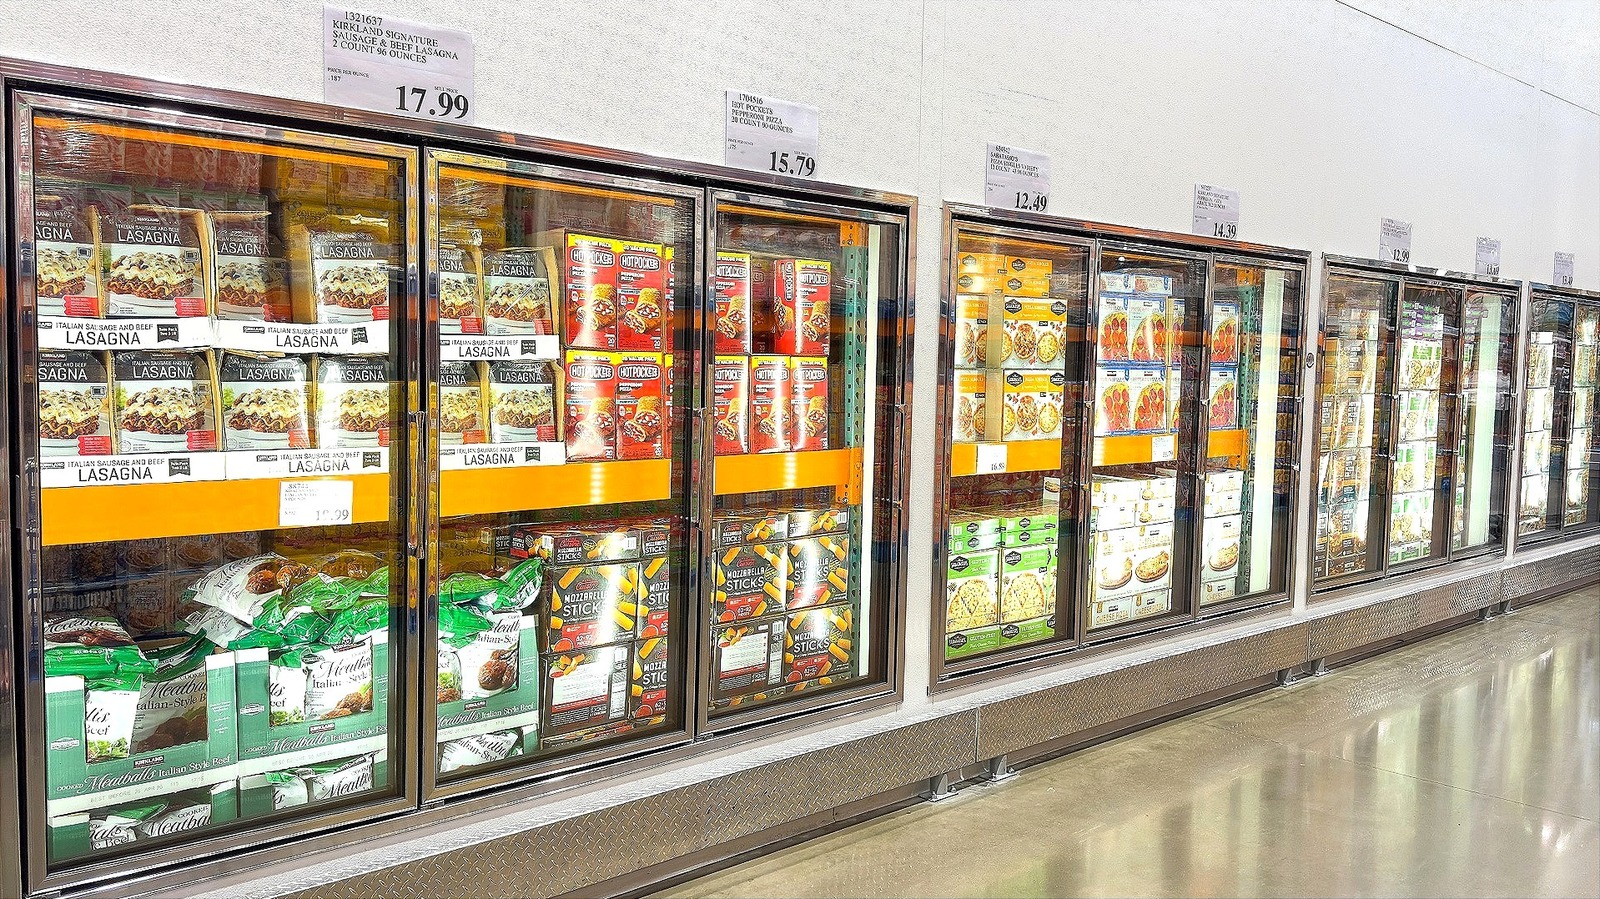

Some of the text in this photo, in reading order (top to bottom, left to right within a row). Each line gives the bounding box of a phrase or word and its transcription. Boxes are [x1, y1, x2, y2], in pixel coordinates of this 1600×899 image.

[345, 11, 383, 26] 1321637
[332, 20, 438, 48] KIRKLAND SIGNATURE
[332, 30, 459, 60] SAUSAGE & BEEF LASAGNA
[332, 40, 427, 64] 2 COUNT 96 OUNCES
[396, 85, 469, 120] 17.99
[732, 100, 774, 115] HOT POCKETS
[732, 108, 783, 125] PEPPERONI PIZZA
[732, 116, 738, 124] 20
[740, 117, 760, 128] COUNT
[770, 122, 793, 134] OUNCES
[769, 150, 816, 176] 15.79
[1015, 192, 1047, 212] 12.49
[36, 227, 74, 240] AGNA
[117, 231, 182, 245] LASAGNA
[1213, 222, 1237, 240] 14.39
[322, 246, 374, 258] LASAGNA
[440, 260, 464, 272] AGNA
[491, 266, 536, 276] LASAGNA
[56, 322, 84, 330] ITALIAN
[86, 323, 118, 331] SAUSAGE
[136, 323, 154, 331] BEEF
[268, 326, 290, 334] ITALIAN
[66, 330, 141, 345] LASAGNA
[276, 334, 338, 348] LASAGNA
[458, 346, 510, 358] LASAGNA
[38, 368, 88, 380] SAGNA
[133, 366, 194, 379] LASAGNA
[240, 368, 294, 380] LASAGNA
[340, 370, 384, 381] ASAGNA
[500, 372, 542, 383] LASAGNA
[440, 375, 466, 385] AGNA
[68, 460, 95, 468] ITALIAN
[97, 459, 130, 467] SAUSAGE
[288, 460, 350, 473] LASAGNA
[464, 454, 515, 466] LASAGNA
[78, 467, 153, 482] LASAGNA
[557, 552, 582, 560] STICKS
[644, 546, 667, 554] STICKS
[727, 566, 765, 579] MOZZARELLA
[726, 576, 764, 591] STICKS
[564, 590, 606, 603] MOZZARELL
[562, 602, 602, 616] STICK
[1135, 606, 1151, 616] CHEESE
[1096, 610, 1128, 625] CHEESE PIZZA
[793, 638, 830, 654] STICKS
[642, 671, 667, 685] STIC
[136, 696, 196, 711] talian-Style
[481, 710, 502, 719] Italian
[520, 702, 534, 711] Beef
[262, 734, 328, 756] Meatballs
[330, 733, 353, 742] Italian
[77, 767, 156, 794] Meatballs
[158, 766, 186, 777] Italian
[188, 761, 210, 774] Style
[212, 754, 232, 766] Beef
